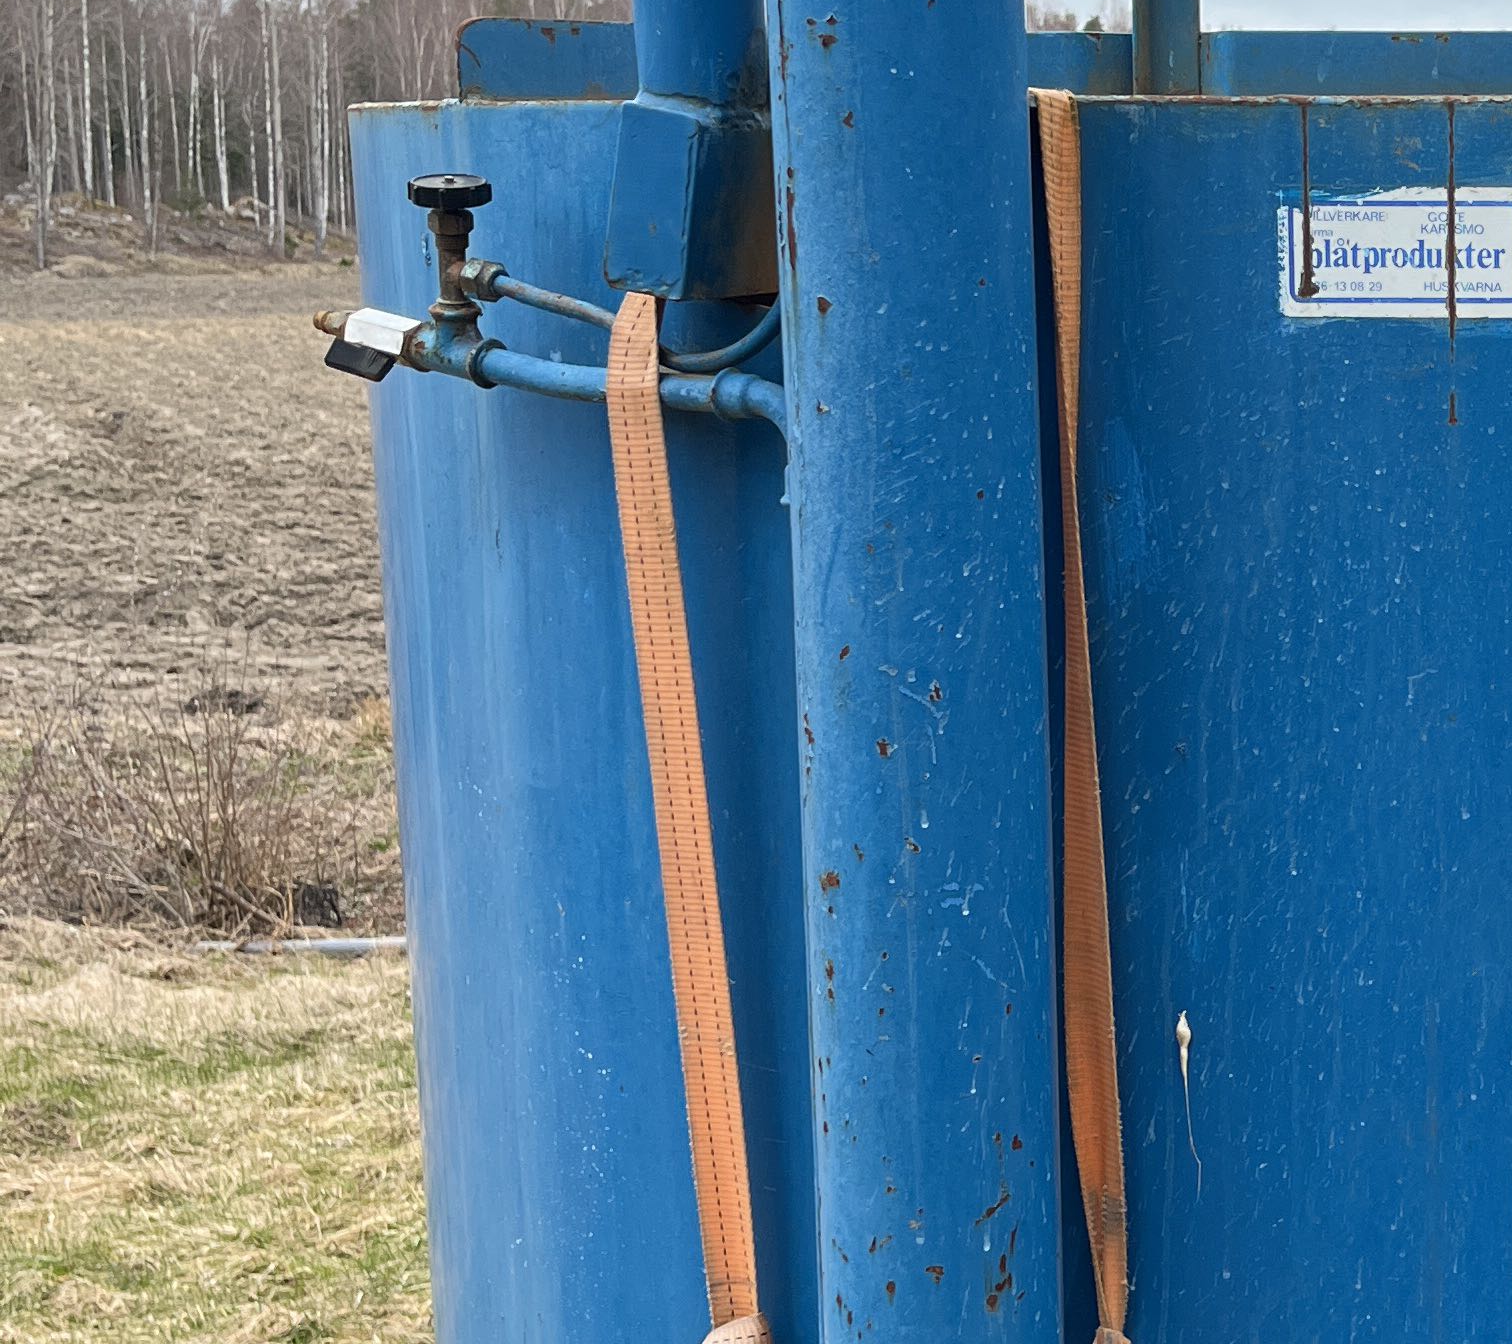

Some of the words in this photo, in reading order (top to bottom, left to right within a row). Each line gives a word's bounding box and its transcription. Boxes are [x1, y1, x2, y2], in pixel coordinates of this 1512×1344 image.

[1312, 211, 1386, 222] ILLVERKARE
[1420, 223, 1485, 235] KARSMO
[1350, 281, 1365, 292] 08
[1368, 281, 1383, 292] 29
